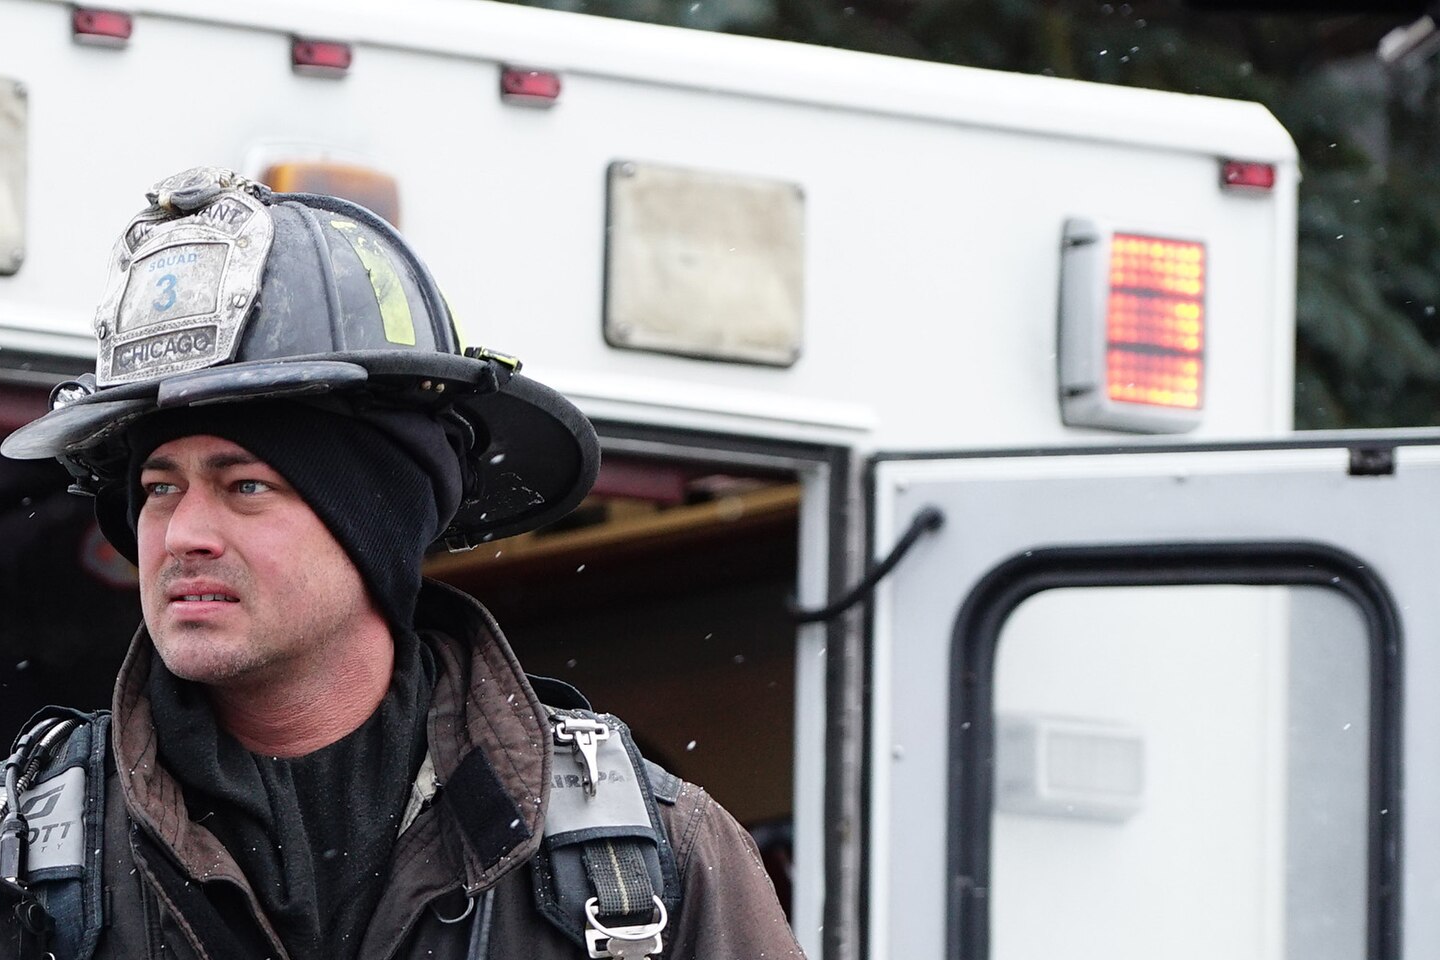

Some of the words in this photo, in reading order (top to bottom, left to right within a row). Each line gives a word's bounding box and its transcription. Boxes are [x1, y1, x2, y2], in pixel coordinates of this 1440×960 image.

[147, 252, 198, 273] SQUAD
[154, 275, 178, 311] 3
[119, 333, 209, 369] CHICAGO
